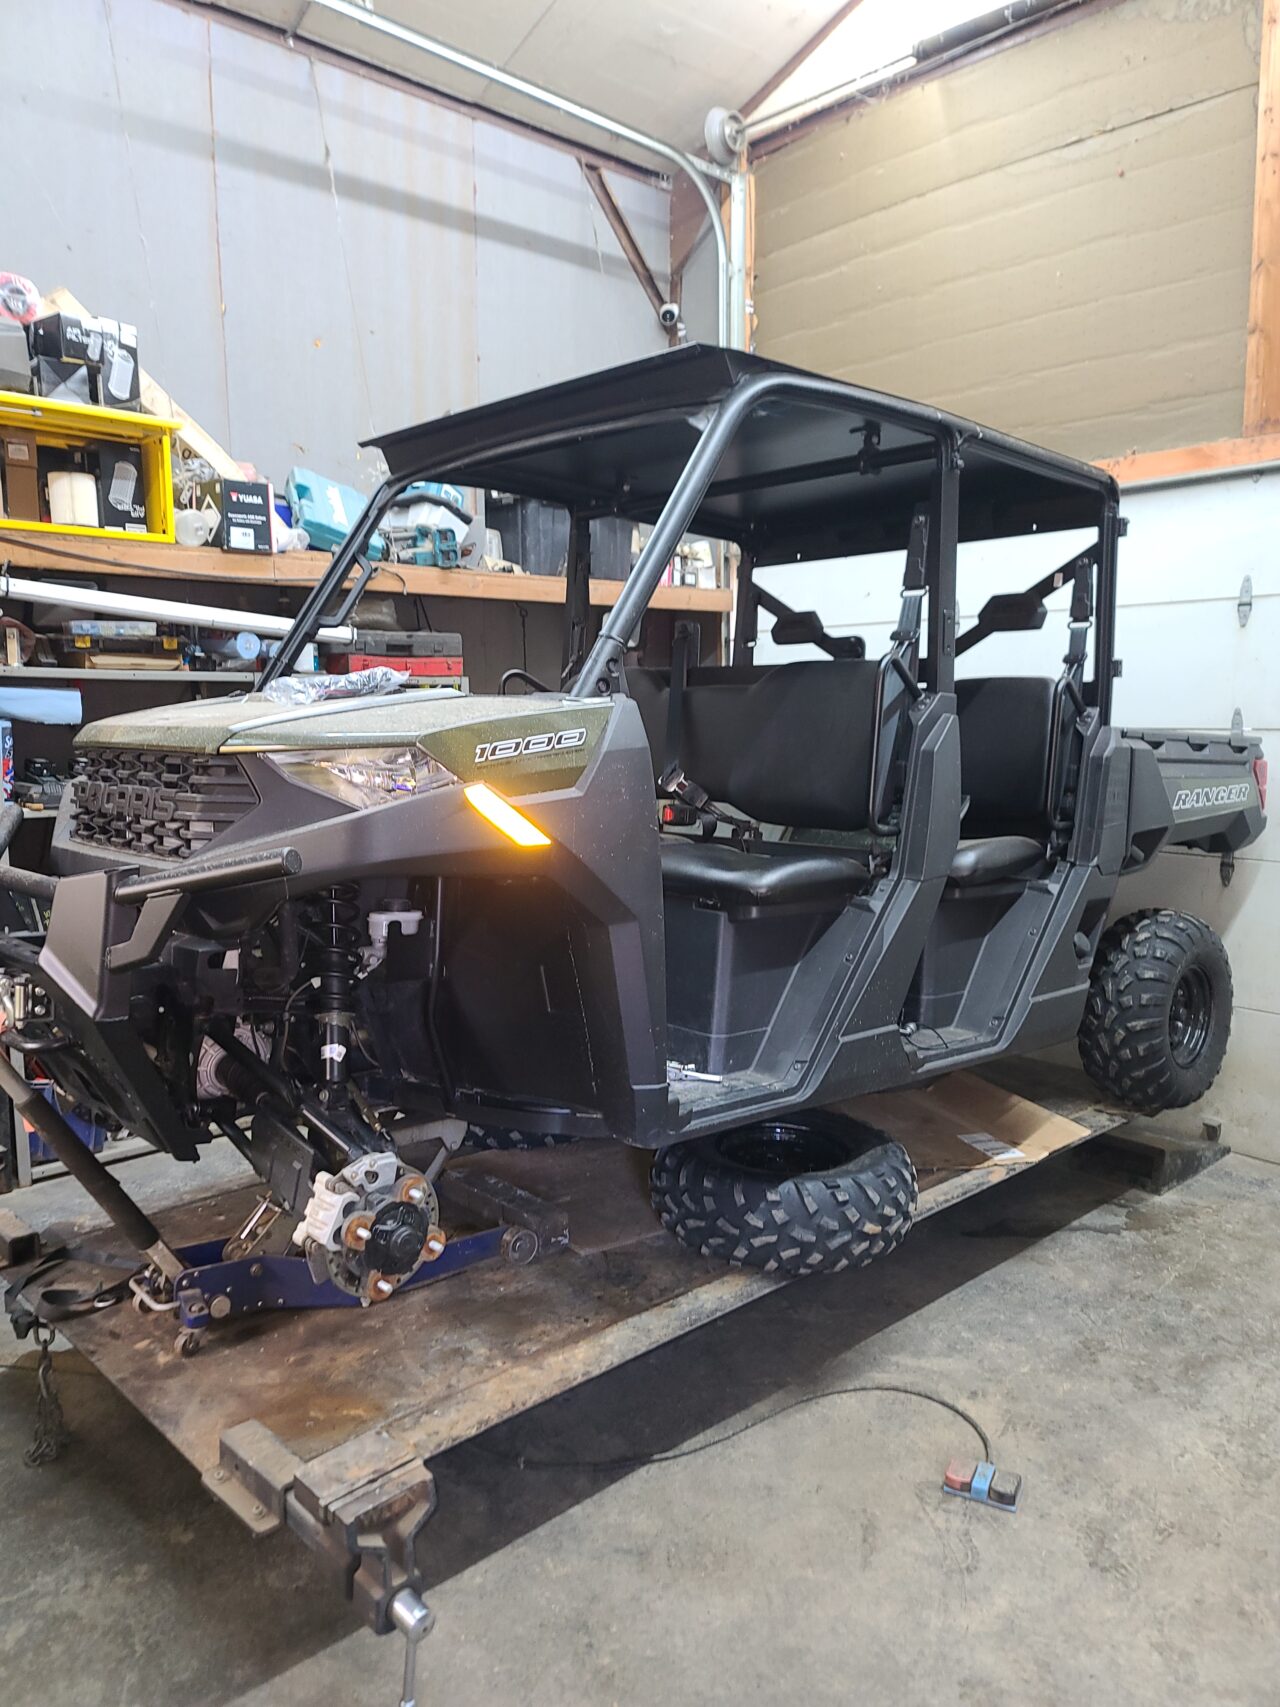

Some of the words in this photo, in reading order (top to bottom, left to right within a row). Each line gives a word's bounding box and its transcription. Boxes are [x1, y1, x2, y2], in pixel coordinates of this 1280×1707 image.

[237, 493, 264, 505] YUASA
[474, 727, 587, 763] 1000
[71, 781, 176, 821] POLARIS
[1172, 783, 1250, 811] RANGER
